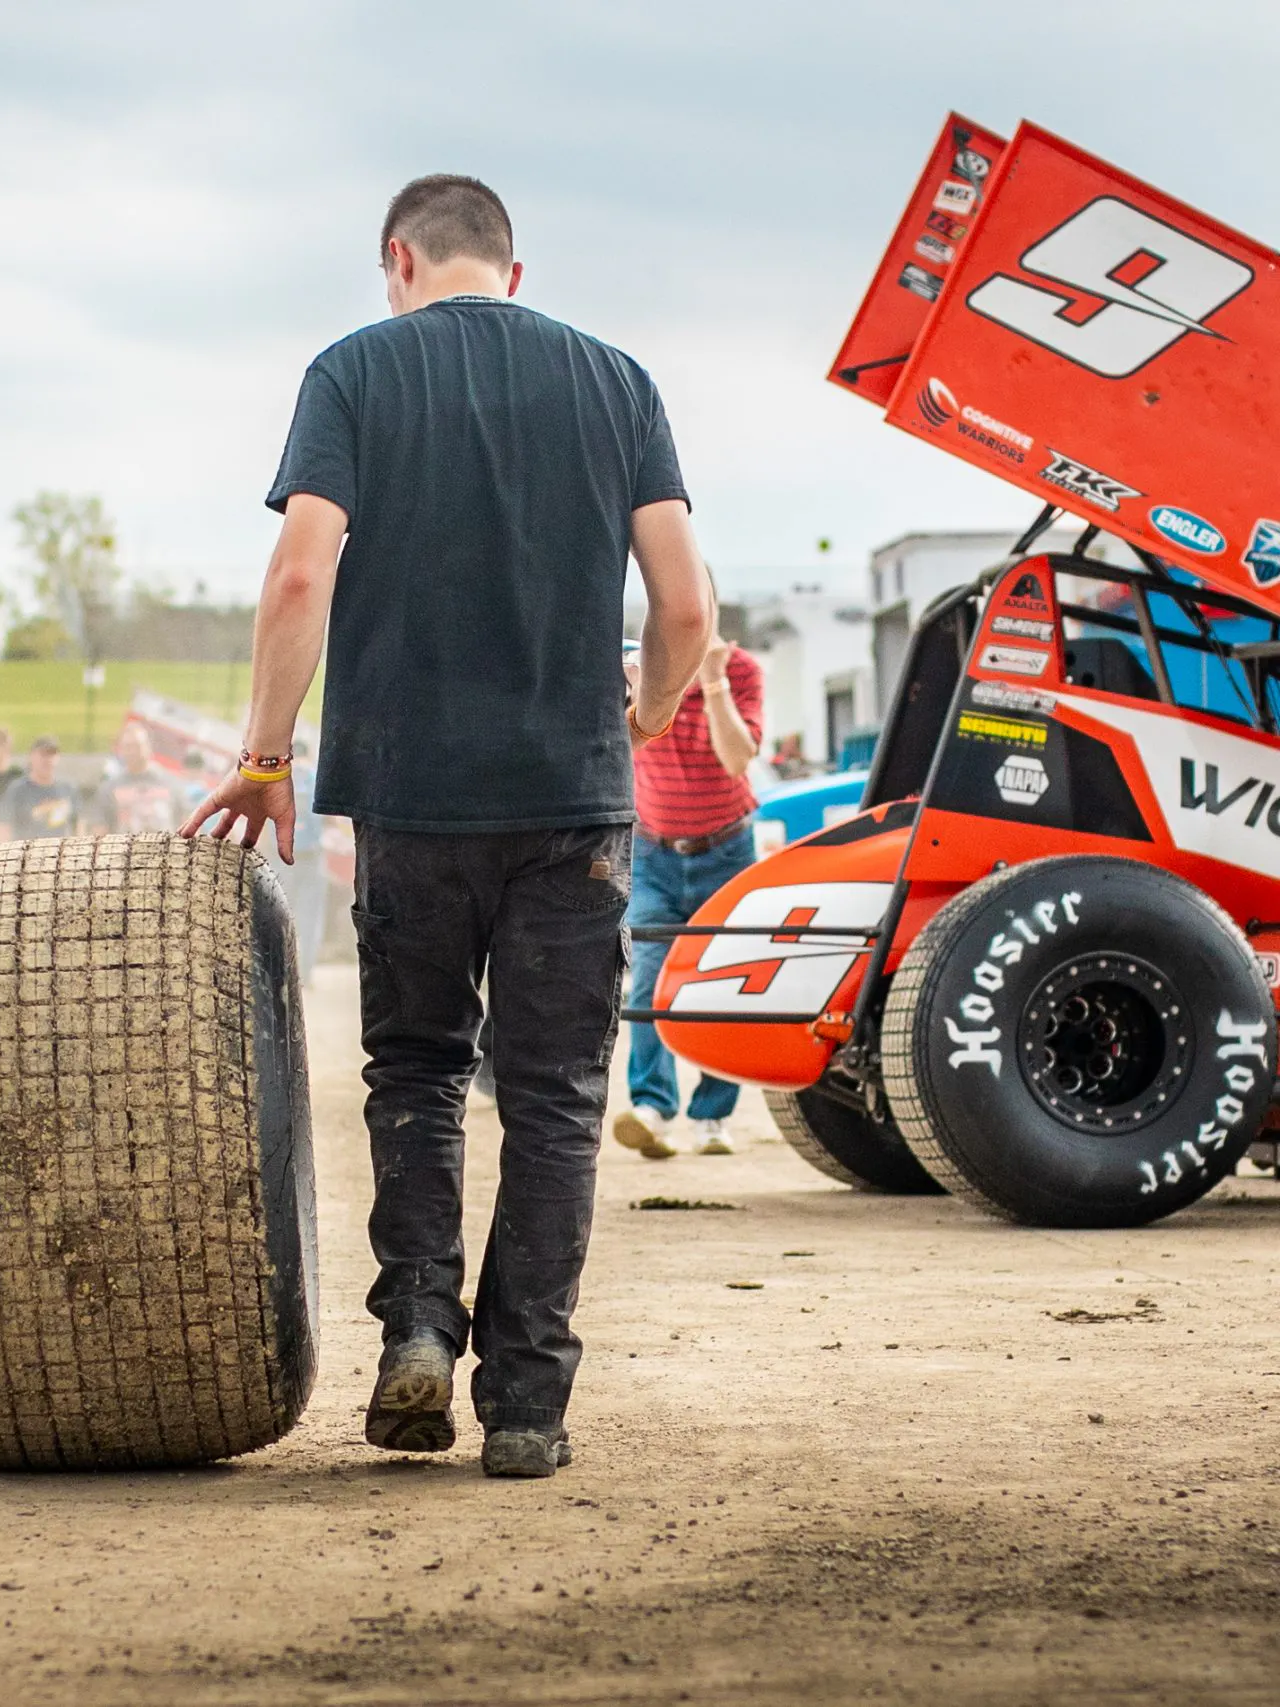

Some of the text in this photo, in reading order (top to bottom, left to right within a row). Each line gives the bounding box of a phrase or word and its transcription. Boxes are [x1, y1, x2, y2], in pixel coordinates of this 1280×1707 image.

[966, 194, 1256, 380] 9
[957, 421, 1024, 463] WARRIORS
[1157, 508, 1221, 552] ENGLER
[1004, 598, 1048, 612] AXALTA
[1004, 765, 1043, 795] NAPA
[669, 880, 897, 1016] 9
[943, 891, 1082, 1079] Hoosier
[1139, 1007, 1268, 1195] Hoosier
